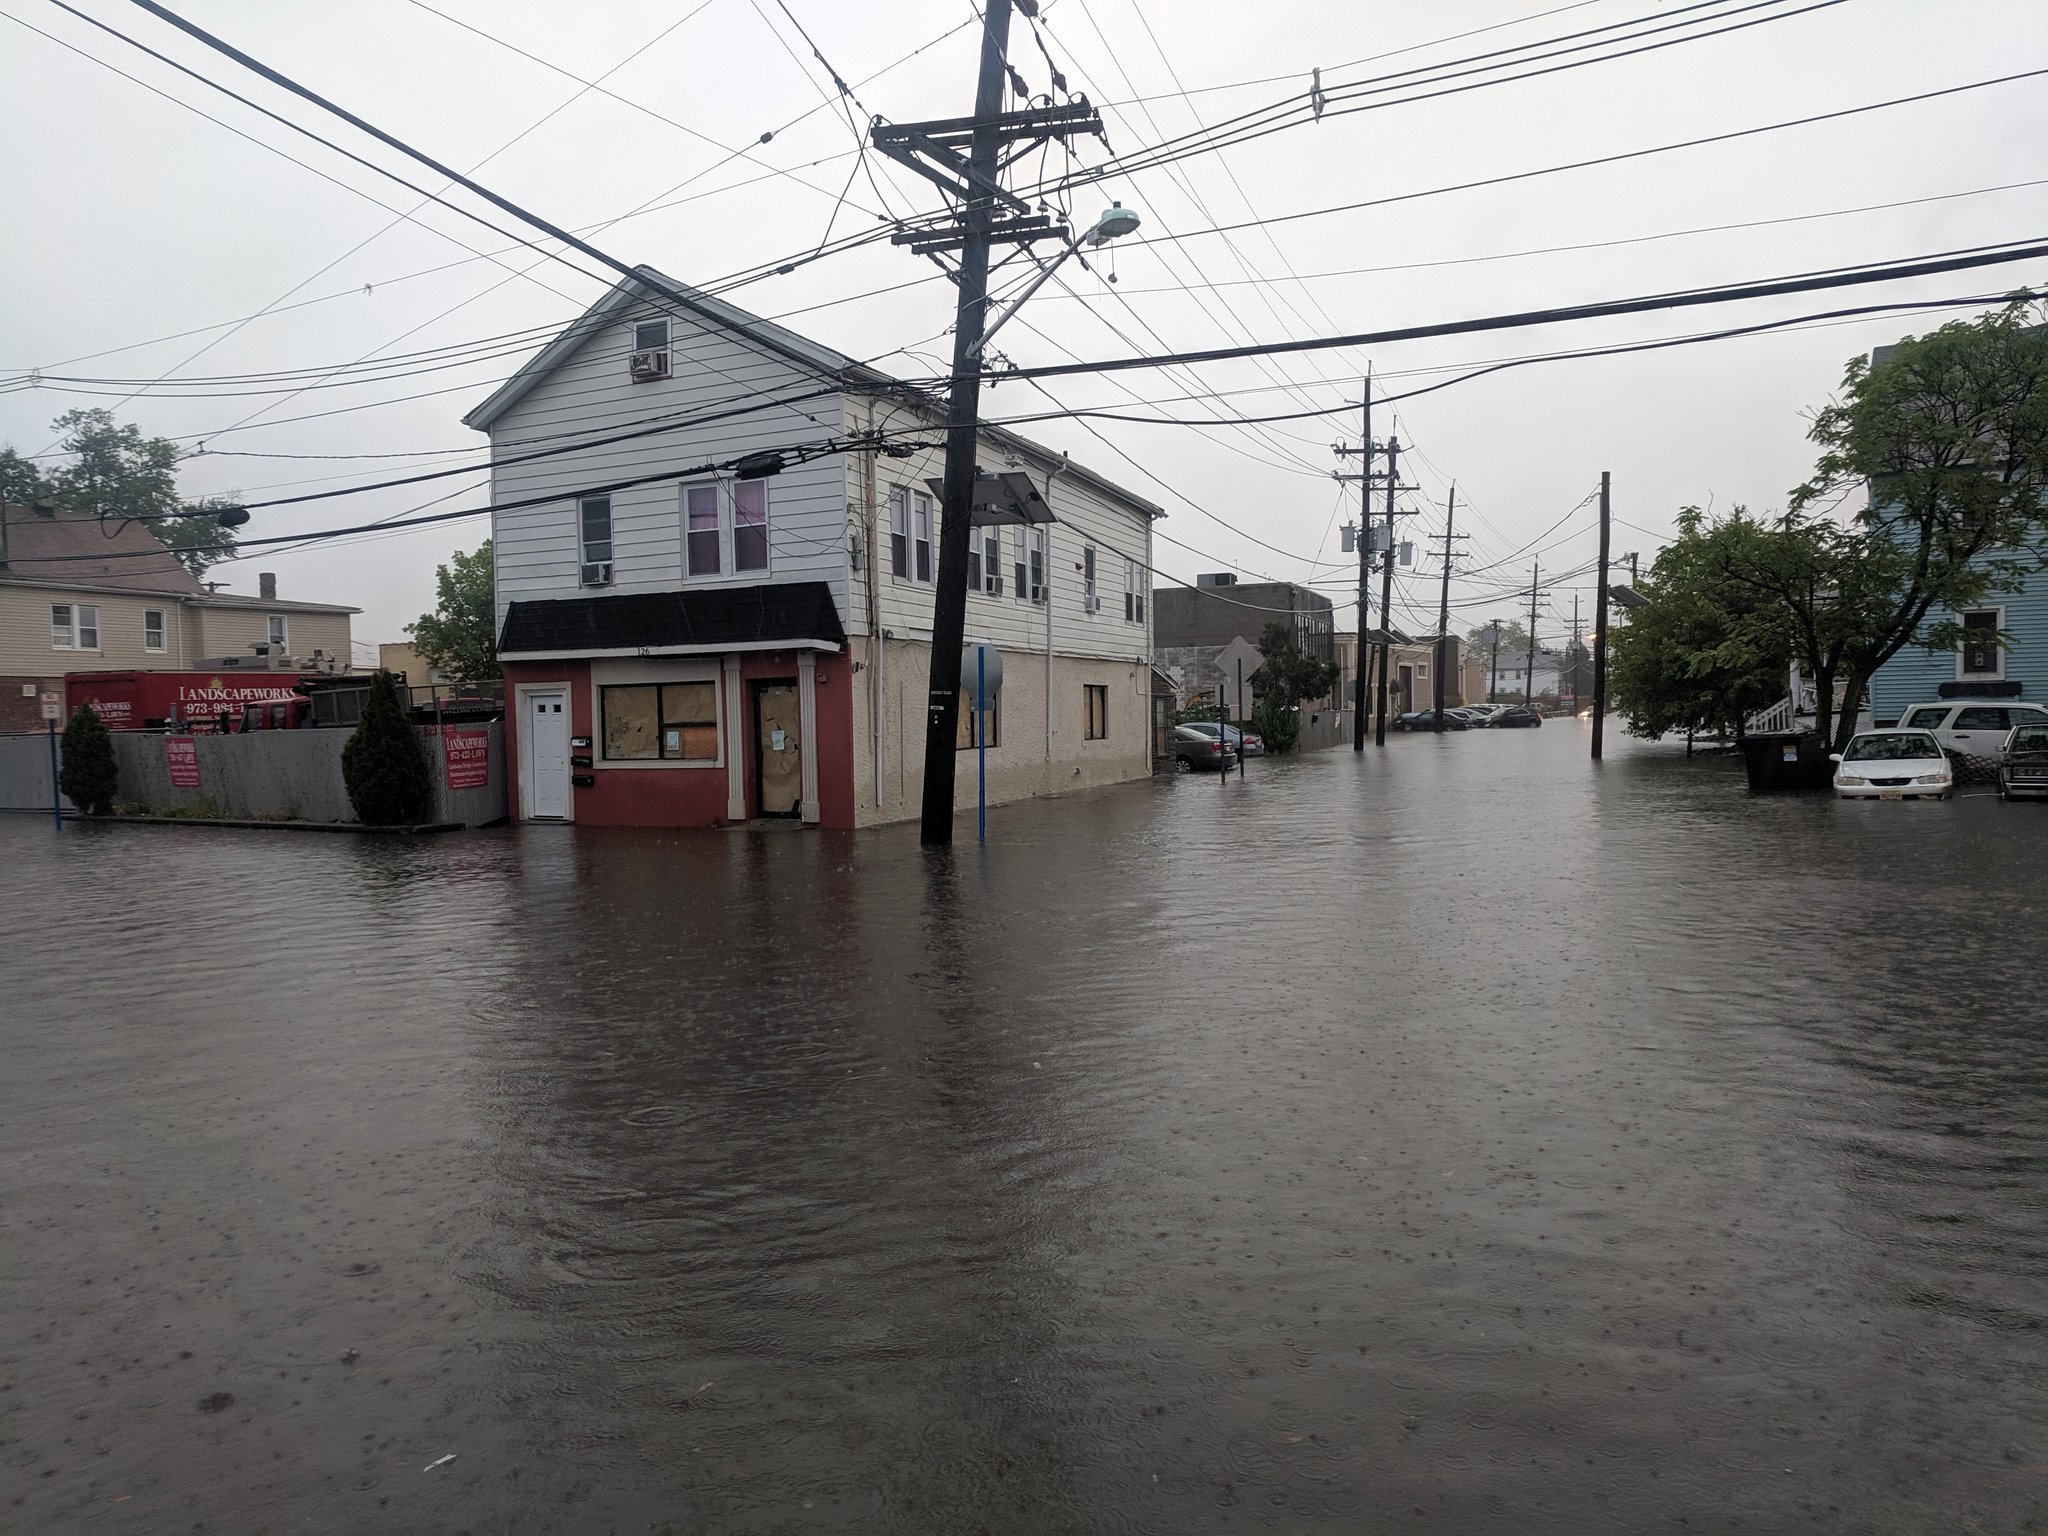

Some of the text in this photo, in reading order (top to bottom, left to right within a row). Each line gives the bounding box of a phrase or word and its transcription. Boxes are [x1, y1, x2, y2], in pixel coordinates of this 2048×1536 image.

[637, 647, 650, 656] 126
[179, 686, 296, 701] LANDSCAPEWORKS
[186, 702, 245, 714] 973-984-1
